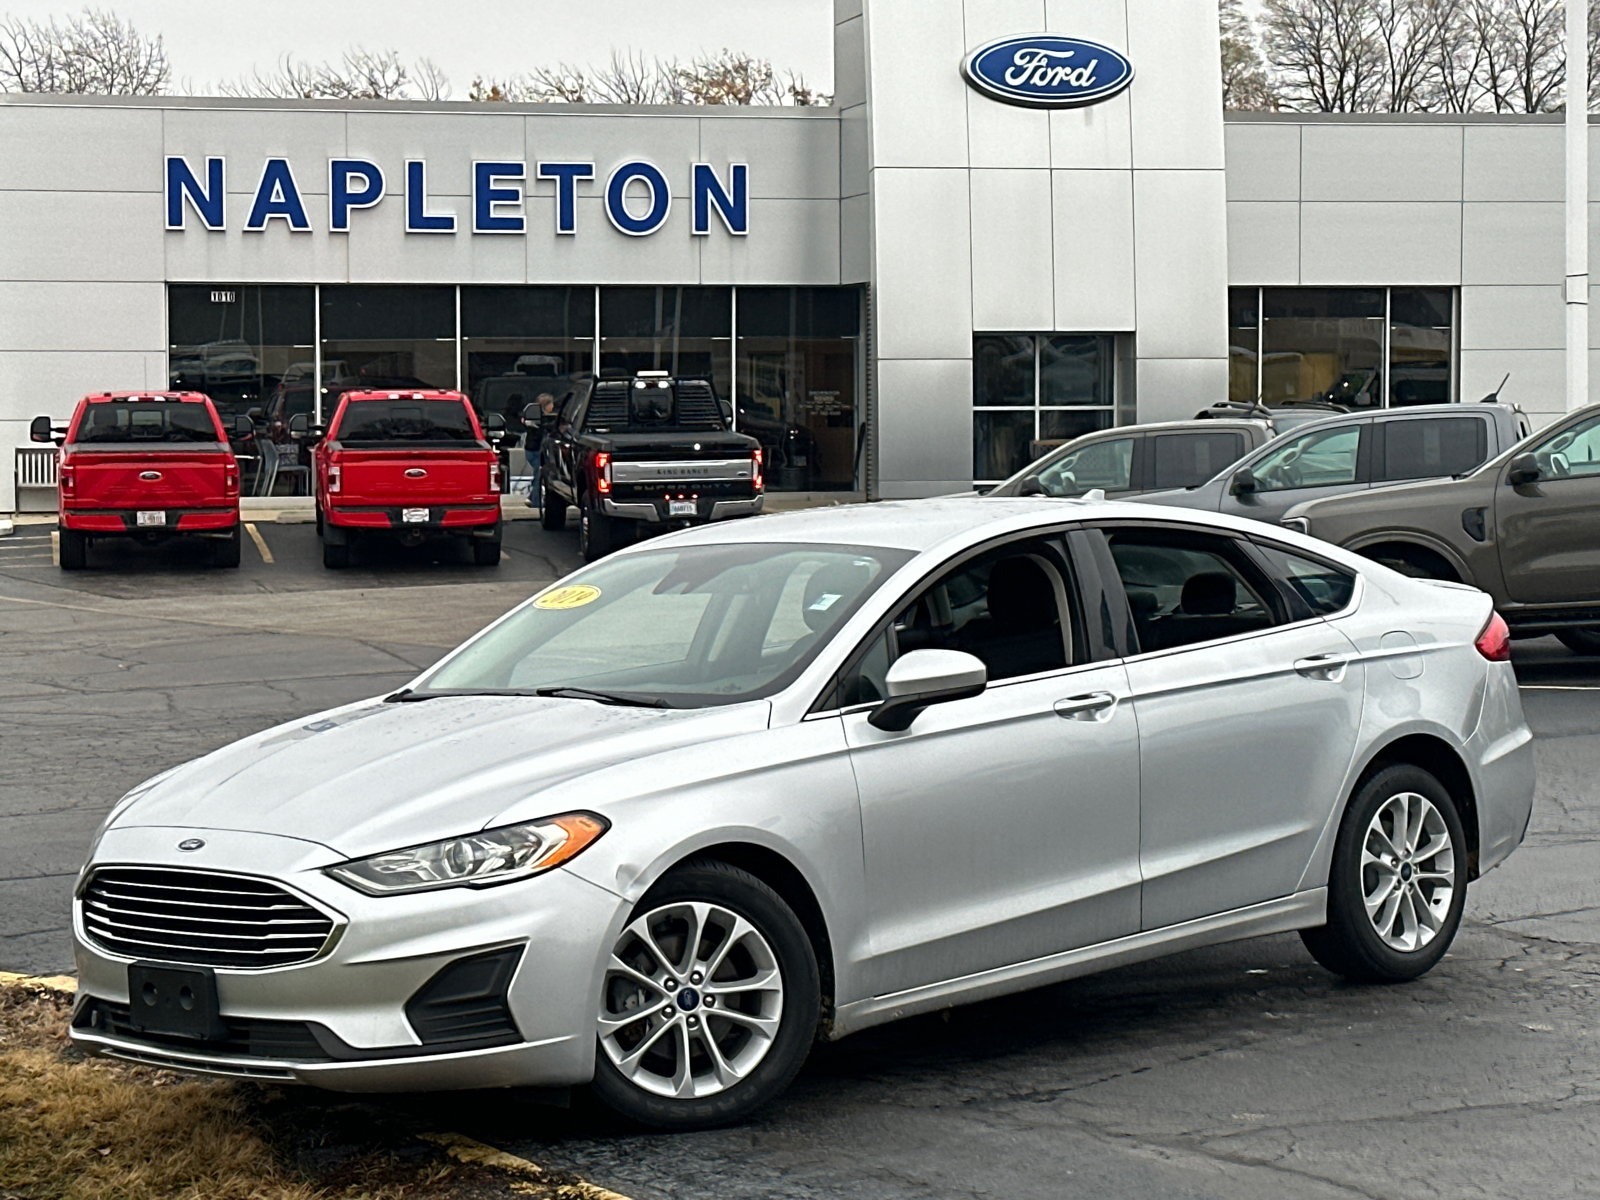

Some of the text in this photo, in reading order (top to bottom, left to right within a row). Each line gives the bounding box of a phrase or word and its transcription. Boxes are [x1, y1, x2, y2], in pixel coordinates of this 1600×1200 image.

[1005, 48, 1098, 87] Ford
[163, 155, 750, 237] NAPLETON
[212, 291, 234, 302] 1010
[656, 468, 678, 476] KING
